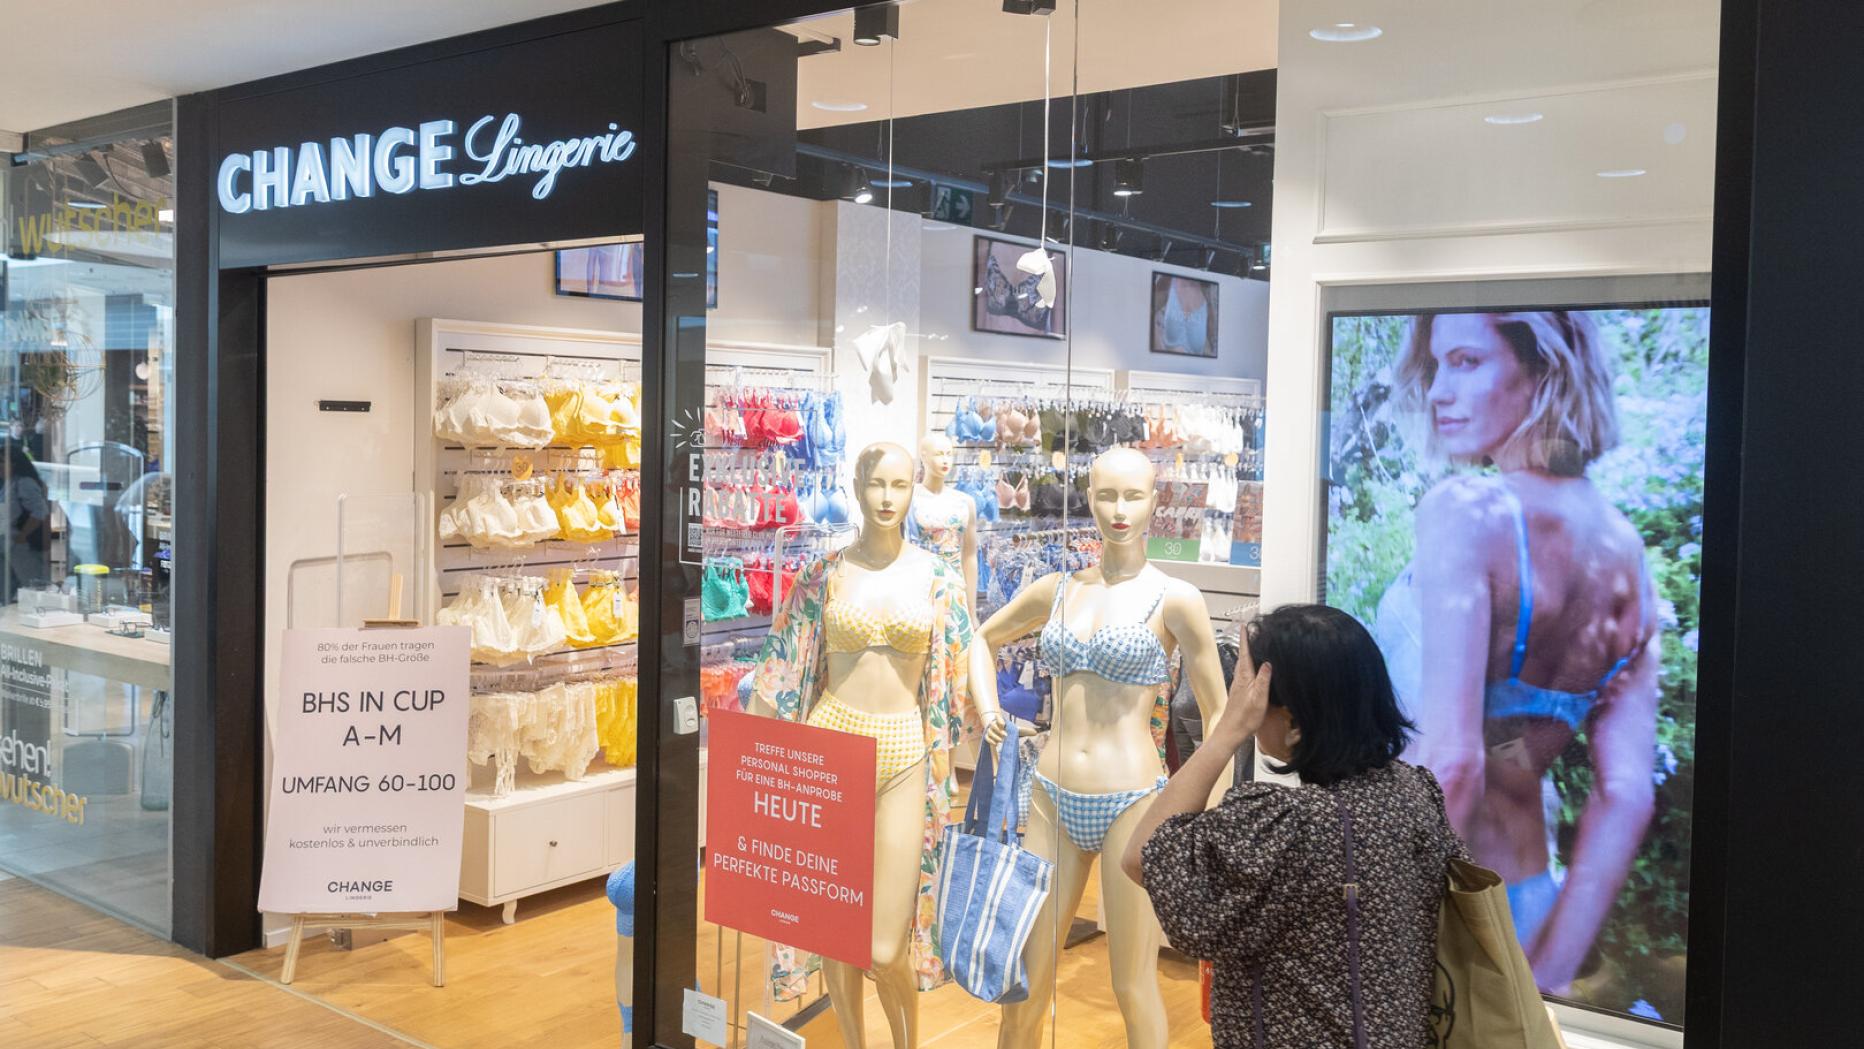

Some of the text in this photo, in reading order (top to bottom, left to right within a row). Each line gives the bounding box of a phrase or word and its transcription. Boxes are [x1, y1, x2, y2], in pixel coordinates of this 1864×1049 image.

[217, 113, 637, 214] CHANGE Lingerie
[1164, 542, 1182, 555] 30
[1, 643, 42, 668] BRILLEN
[318, 641, 435, 652] 80% der Frauen tragen
[321, 653, 430, 664] die falsche BH-Größe
[302, 690, 445, 714] BHS IN CUP
[0, 730, 52, 778] ehen!
[755, 742, 824, 766] TREFFE UNSERE
[741, 755, 838, 785] PERSONAL SHOPPER
[282, 774, 456, 794] UMFANG 60-100
[736, 768, 842, 803] FÜR EINE BH-ANPROBE
[754, 791, 823, 828] HEUTE
[323, 824, 407, 834] wir vermessen
[289, 836, 439, 849] kostenlos & unverbindlich
[737, 835, 838, 876] & FINDE DEINE
[327, 880, 393, 893] CHANGE
[714, 853, 864, 907] PERFEKTE PASSFORM
[770, 909, 799, 924] CHANGE
